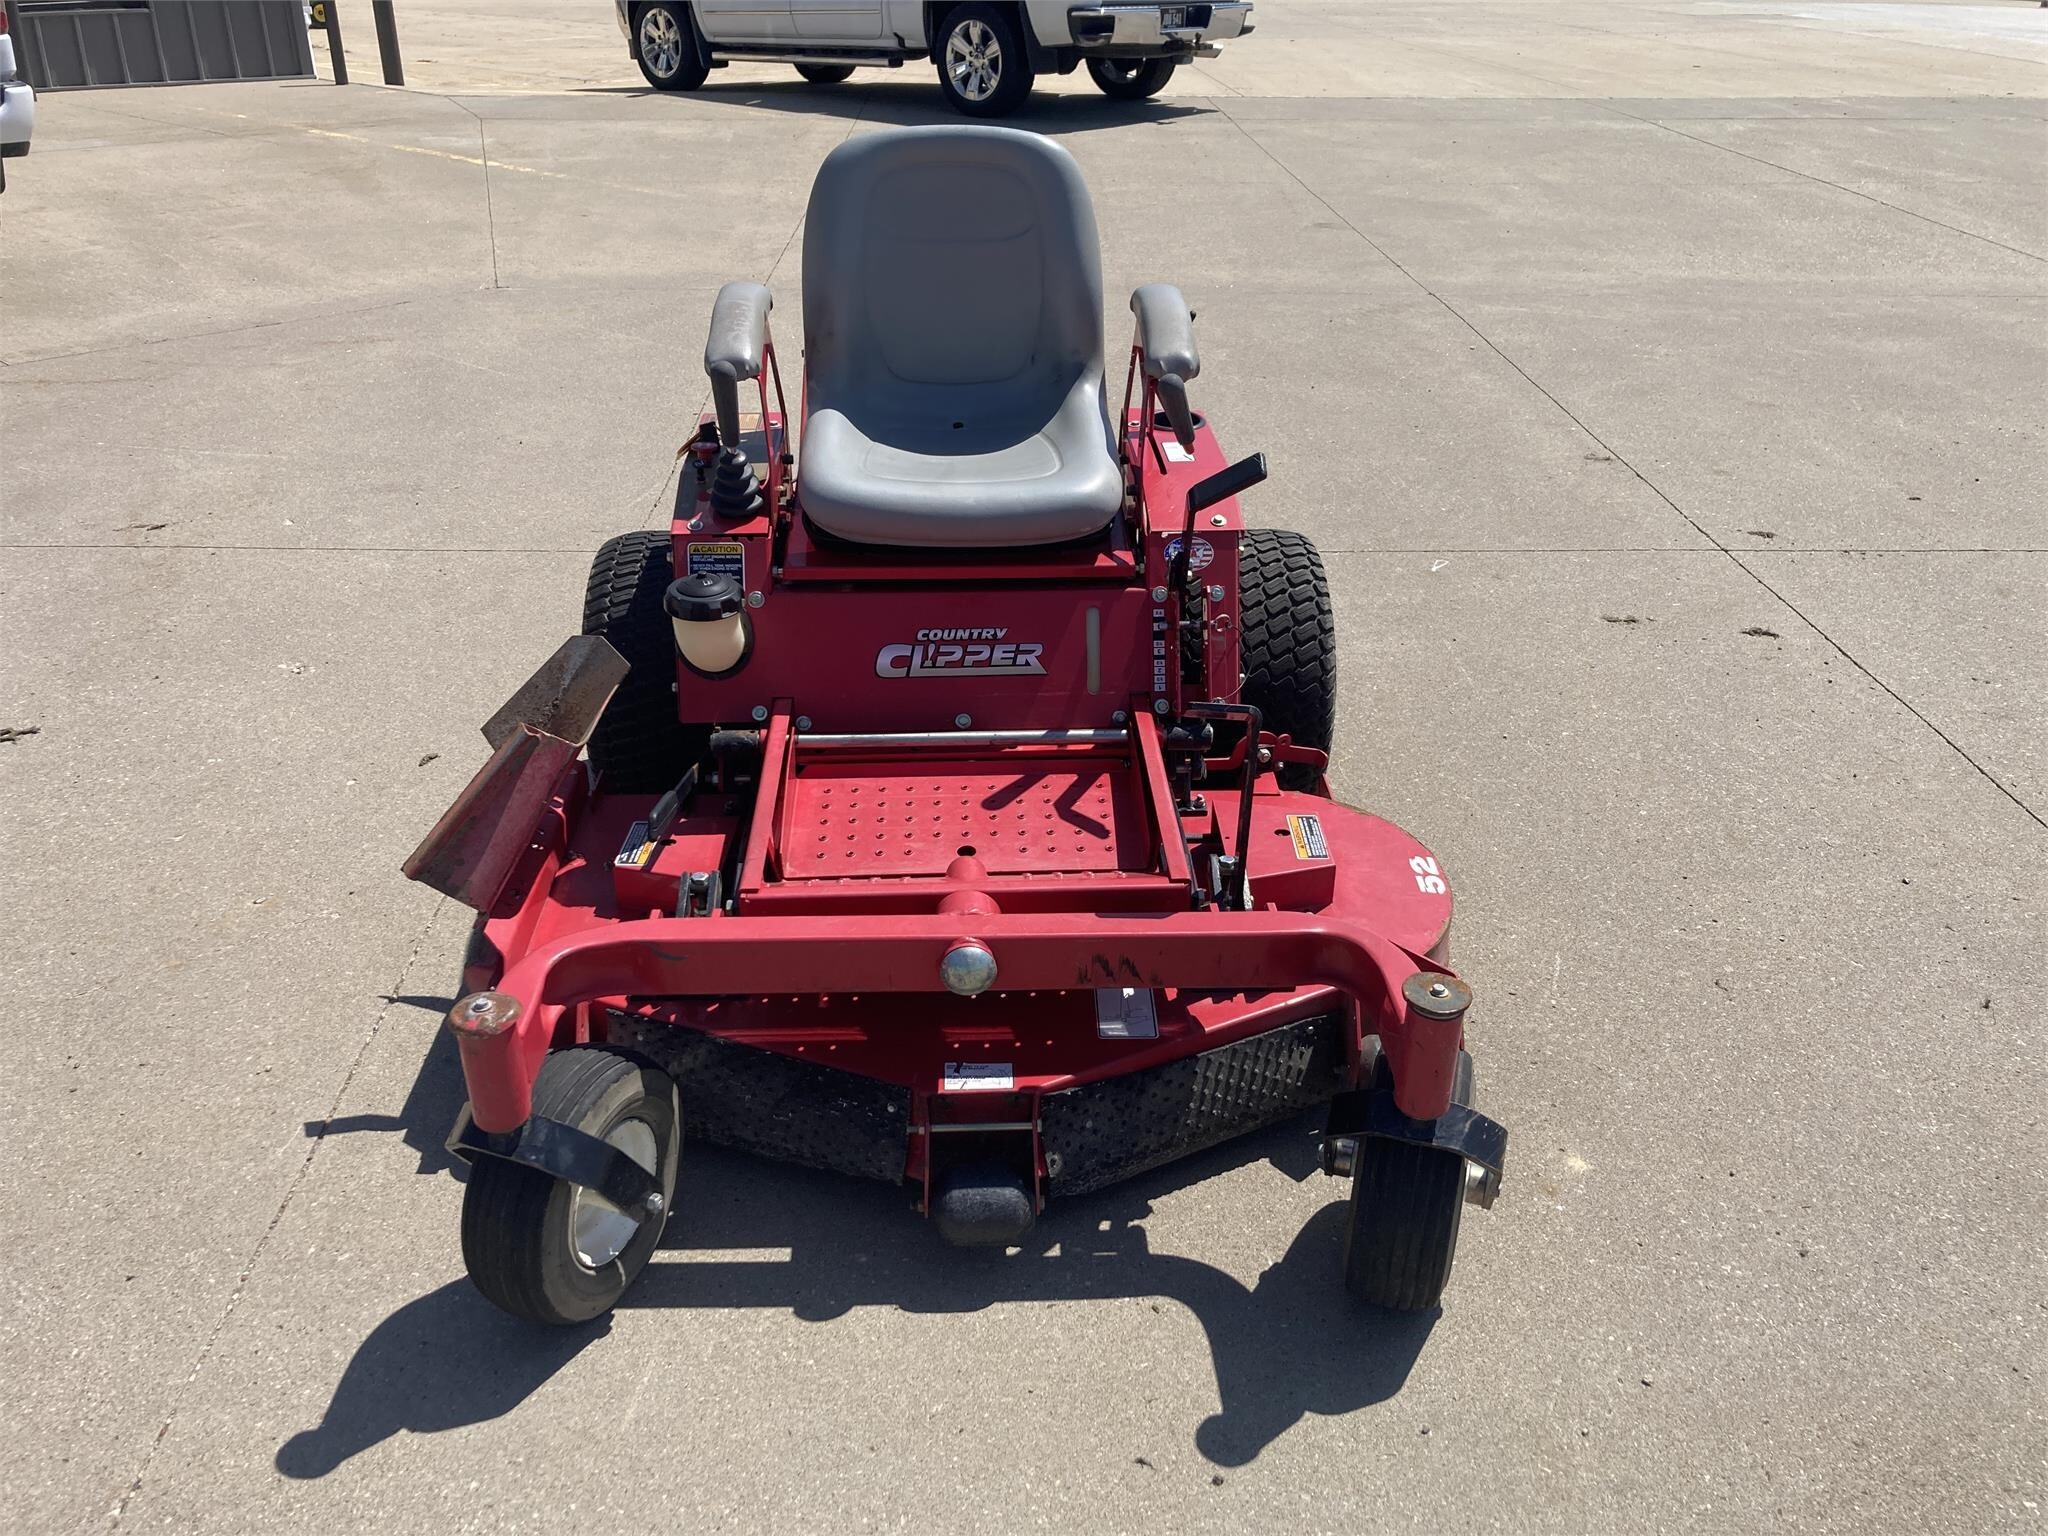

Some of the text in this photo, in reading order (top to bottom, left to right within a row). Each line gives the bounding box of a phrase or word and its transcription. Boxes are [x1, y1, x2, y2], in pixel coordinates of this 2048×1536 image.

[916, 627, 1008, 641] COUNTRY
[875, 643, 1048, 678] CLIPPER
[1408, 855, 1446, 895] 52
